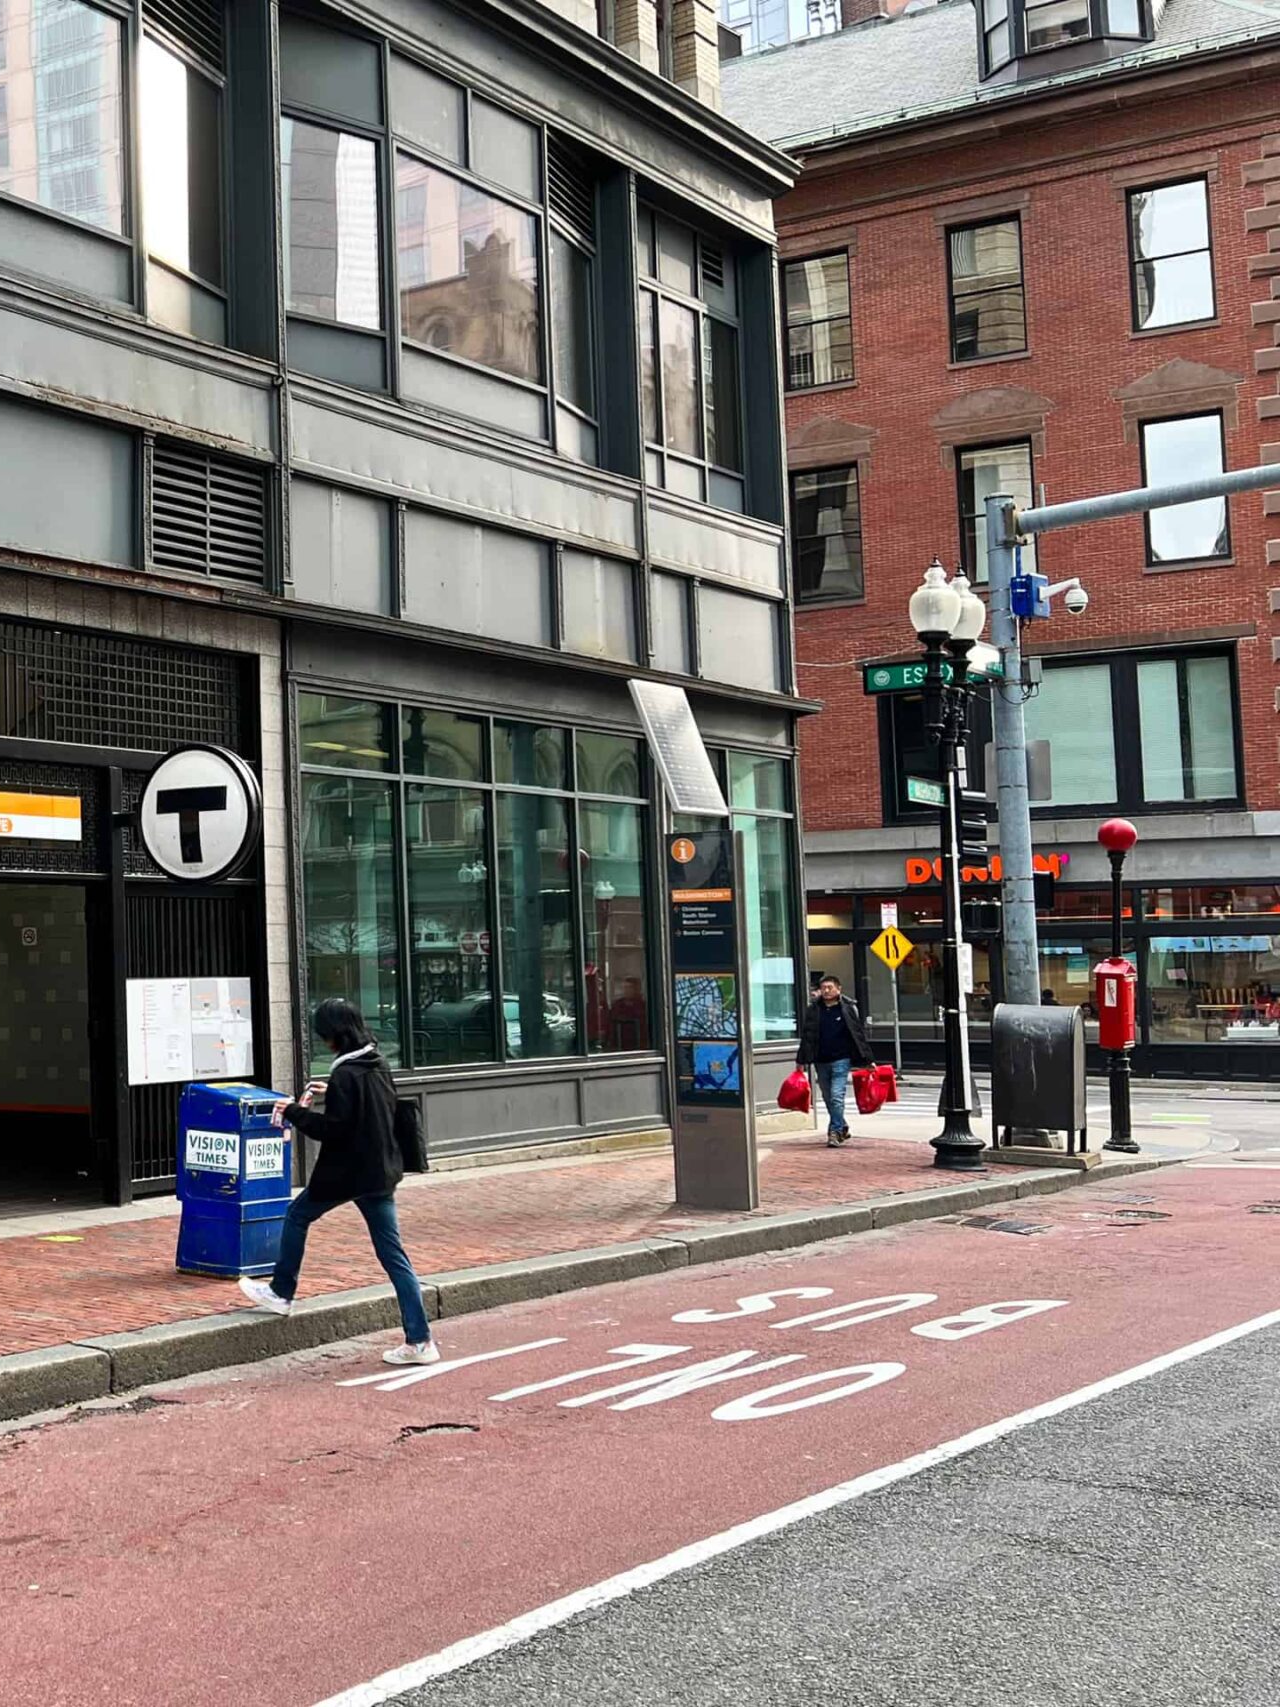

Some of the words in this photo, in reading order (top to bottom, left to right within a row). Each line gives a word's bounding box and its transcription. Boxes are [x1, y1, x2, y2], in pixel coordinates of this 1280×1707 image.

[156, 785, 227, 864] T
[189, 1135, 236, 1152] VISION
[248, 1143, 281, 1157] VISION
[196, 1151, 228, 1165] TIMES
[253, 1159, 276, 1169] TIMES
[671, 1286, 1070, 1341] BUS
[335, 1337, 907, 1421] ONLY
